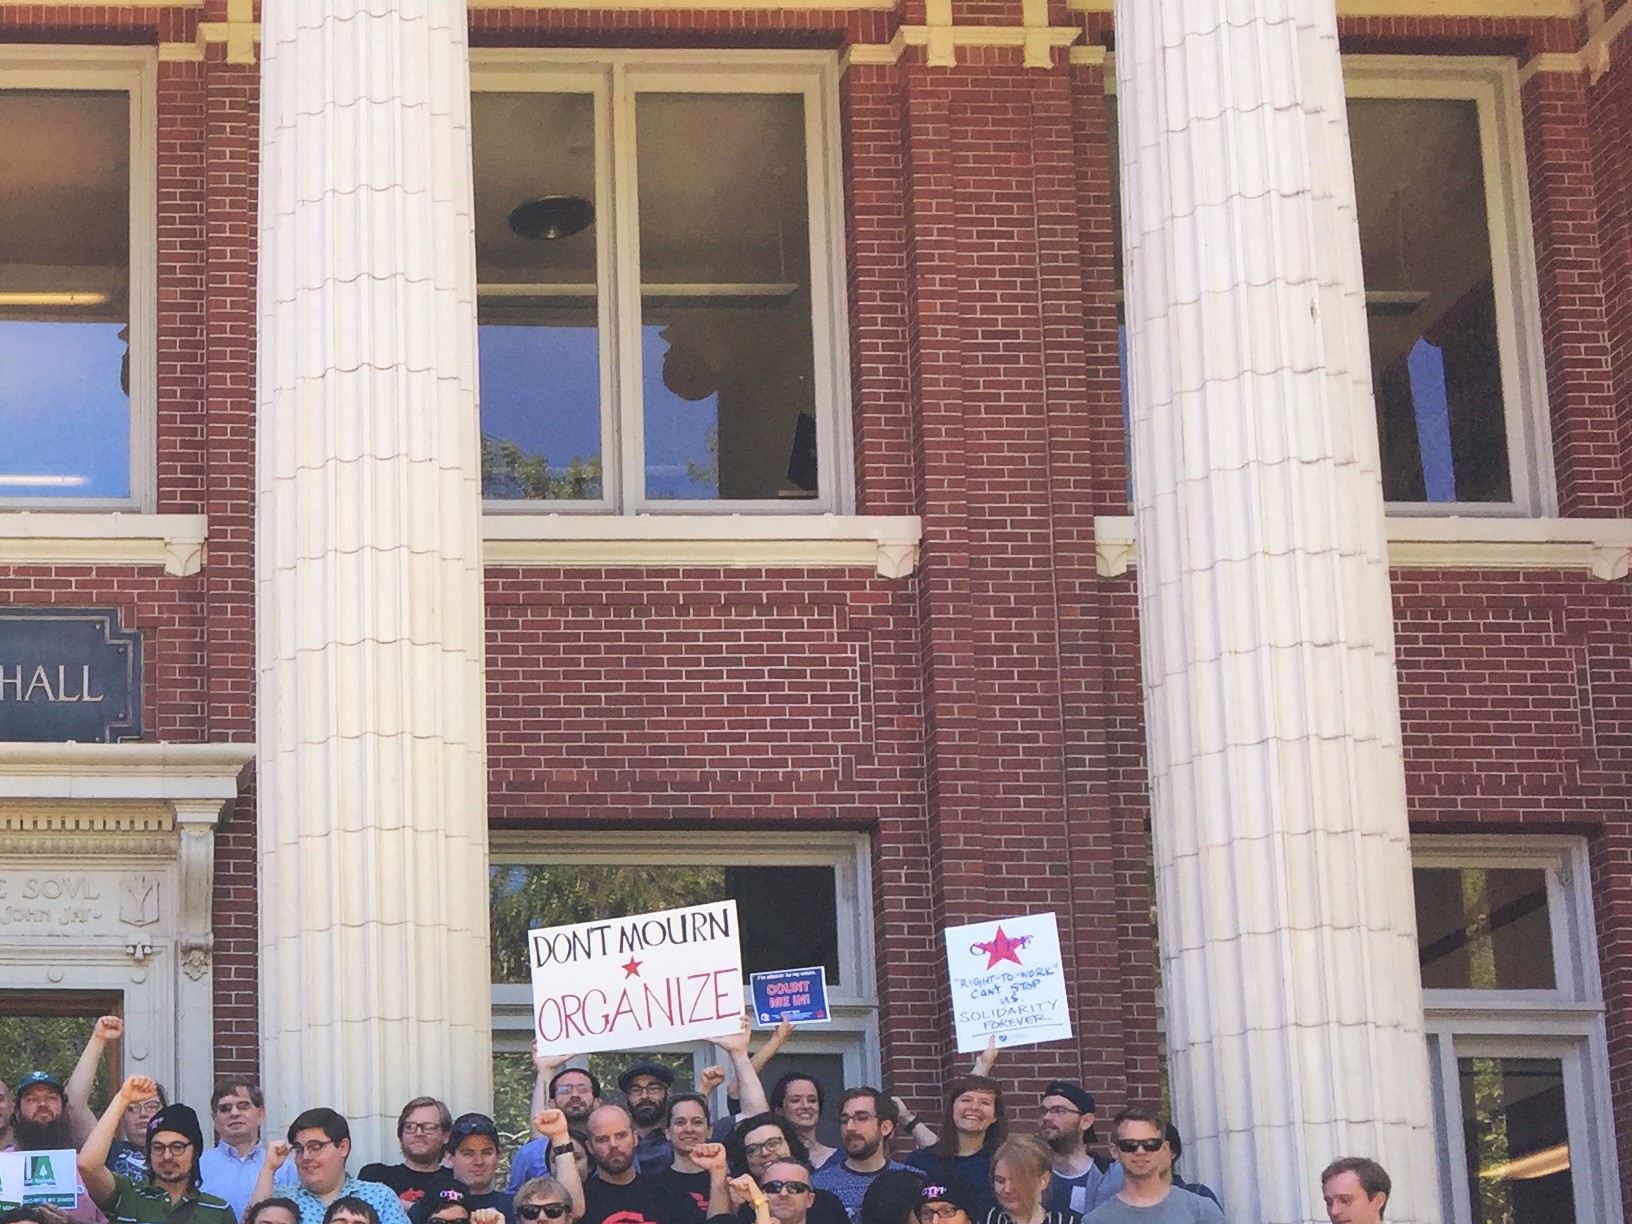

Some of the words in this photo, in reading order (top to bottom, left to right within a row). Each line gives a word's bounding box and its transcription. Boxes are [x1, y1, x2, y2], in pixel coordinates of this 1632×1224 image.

[618, 907, 731, 954] MOURN
[1010, 979, 1042, 993] STOP
[538, 967, 742, 1043] ORGANIZE
[959, 998, 1059, 1024] SOLIDARITY
[983, 1013, 1053, 1031] FOREVER
